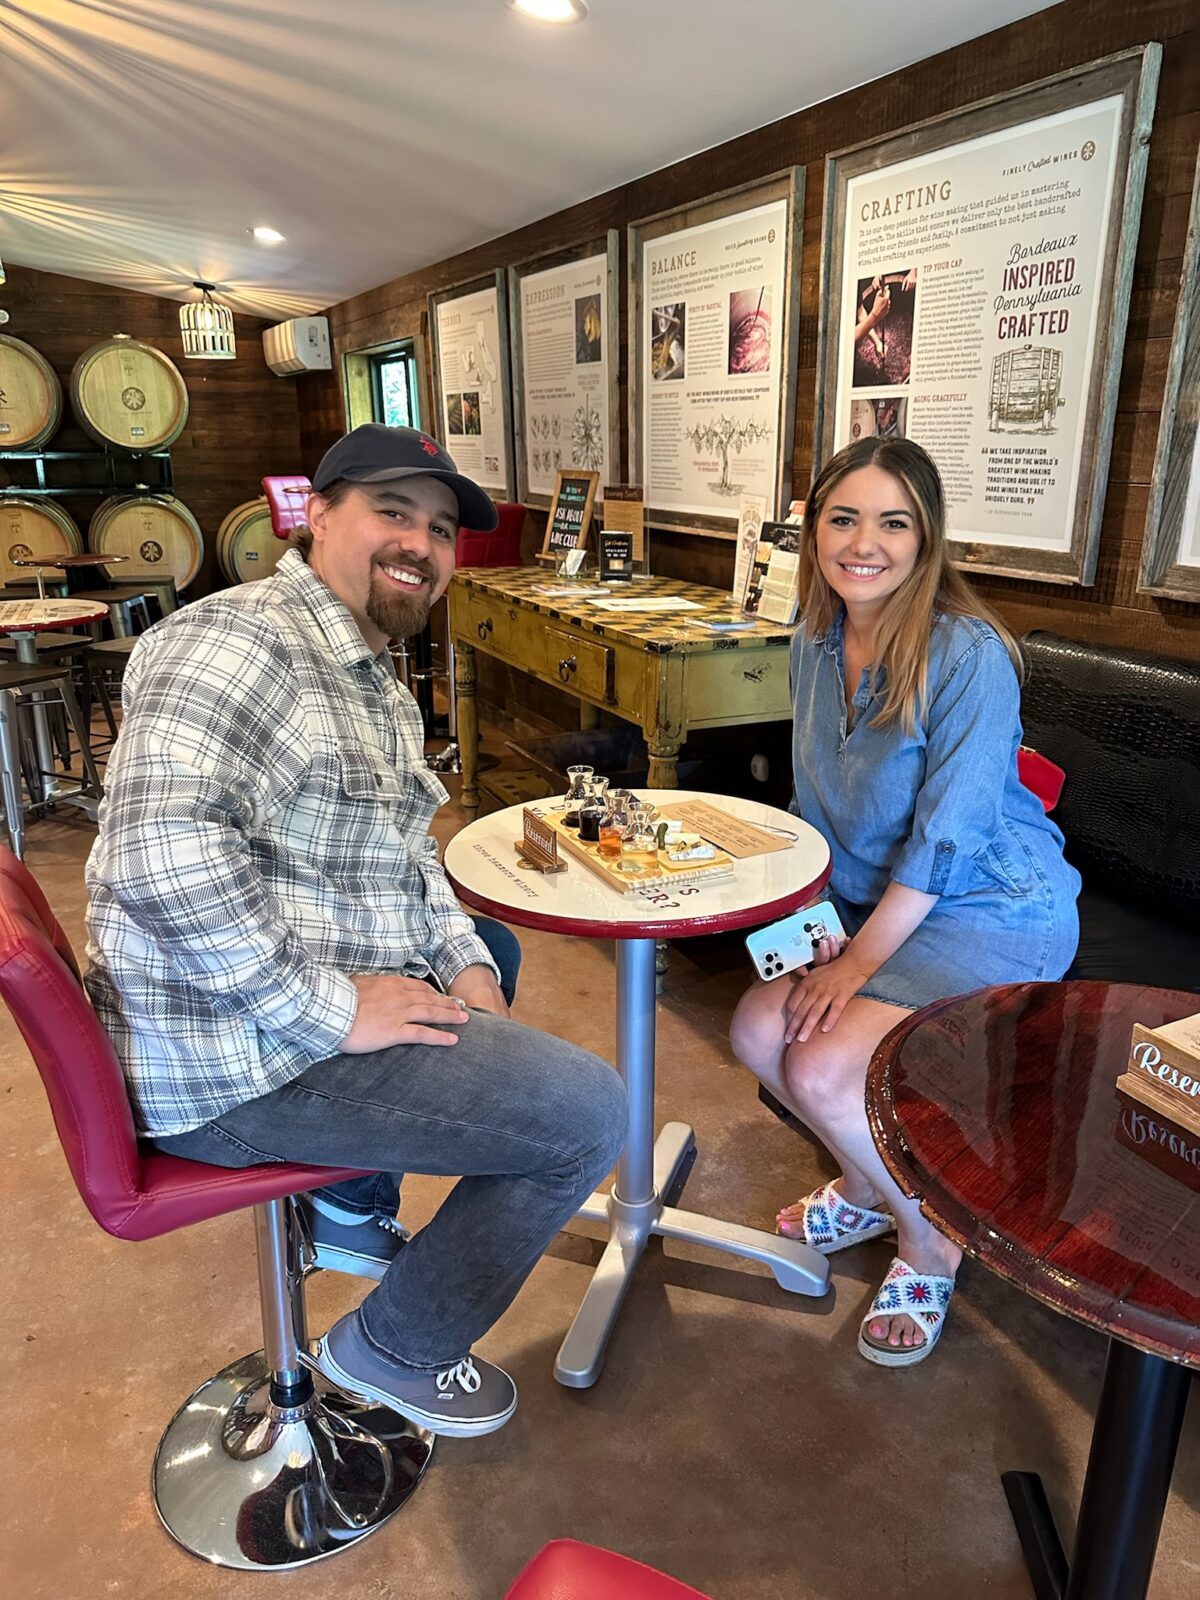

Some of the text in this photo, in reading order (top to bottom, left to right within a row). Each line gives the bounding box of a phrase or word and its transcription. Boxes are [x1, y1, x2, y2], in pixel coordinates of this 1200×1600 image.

[1002, 163, 1026, 177] FINELY
[1053, 149, 1077, 163] WINES
[861, 180, 951, 222] CRAFTING
[915, 224, 928, 233] that
[929, 220, 949, 230] ensure
[960, 211, 985, 223] deliver
[986, 206, 1002, 217] only
[1004, 203, 1015, 212] the
[1017, 198, 1032, 209] best
[1034, 186, 1081, 205] handcrafted
[919, 214, 928, 222] for
[930, 210, 944, 220] wine
[946, 204, 967, 216] making
[969, 198, 984, 210] that
[985, 192, 1008, 208] guided
[1020, 187, 1029, 197] in
[1031, 178, 1069, 194] mastering
[920, 234, 930, 243] and
[960, 218, 997, 234] commitment
[999, 217, 1006, 225] to
[1008, 213, 1020, 223] not
[1021, 209, 1037, 222] just
[1039, 204, 1065, 216] making
[652, 251, 696, 275] BALANCE
[1007, 234, 1077, 265] Bordeaux
[1002, 258, 1075, 291] INSPIRED
[994, 284, 1082, 315] Pennsylvania
[998, 309, 1069, 340] CRAFTED
[1033, 456, 1058, 465] WORLD'S
[556, 507, 584, 523] ASK ABOUT
[488, 857, 515, 878] hammers
[513, 878, 539, 898] winery
